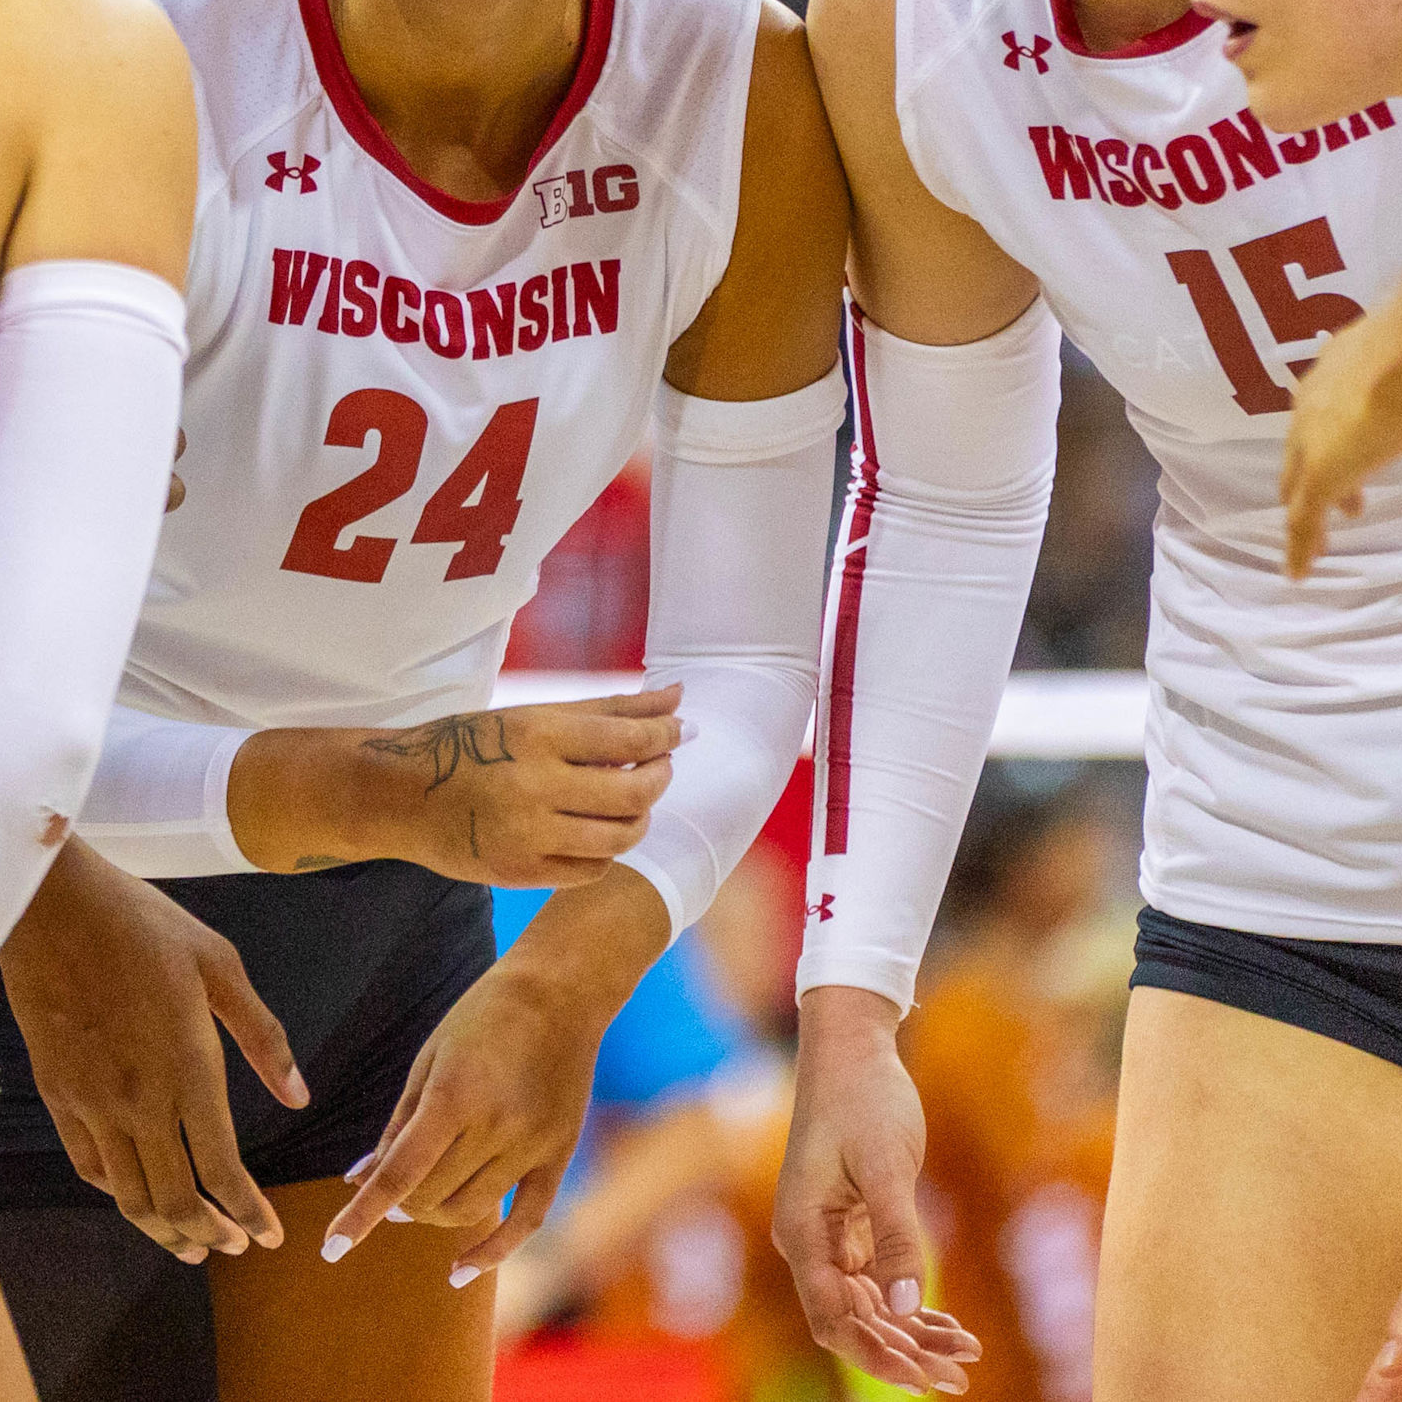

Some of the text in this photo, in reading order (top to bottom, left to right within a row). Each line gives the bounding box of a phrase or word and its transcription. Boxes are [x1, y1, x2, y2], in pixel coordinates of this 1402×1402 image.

[268, 247, 621, 361] WISCONSIN
[1164, 215, 1368, 417] 15
[280, 387, 540, 584] 24
